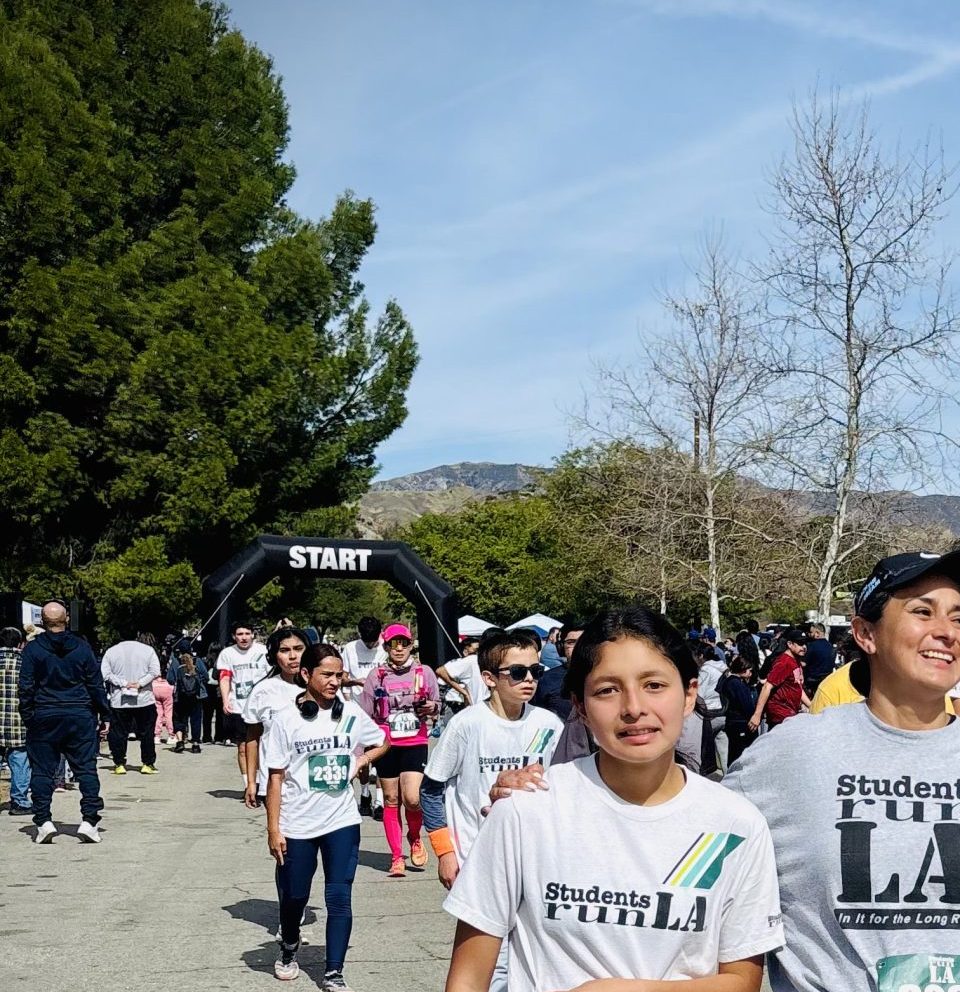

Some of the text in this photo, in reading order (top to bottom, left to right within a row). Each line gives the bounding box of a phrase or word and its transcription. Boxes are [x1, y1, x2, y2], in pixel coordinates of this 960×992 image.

[289, 545, 372, 572] START
[333, 736, 351, 749] LA
[479, 756, 521, 765] Students
[313, 765, 348, 781] 2339
[545, 881, 651, 909] Students
[544, 891, 707, 932] run LA
[839, 913, 851, 924] In
[855, 913, 866, 924] It
[869, 913, 890, 924] for
[892, 913, 912, 924] the
[915, 913, 948, 926] Long
